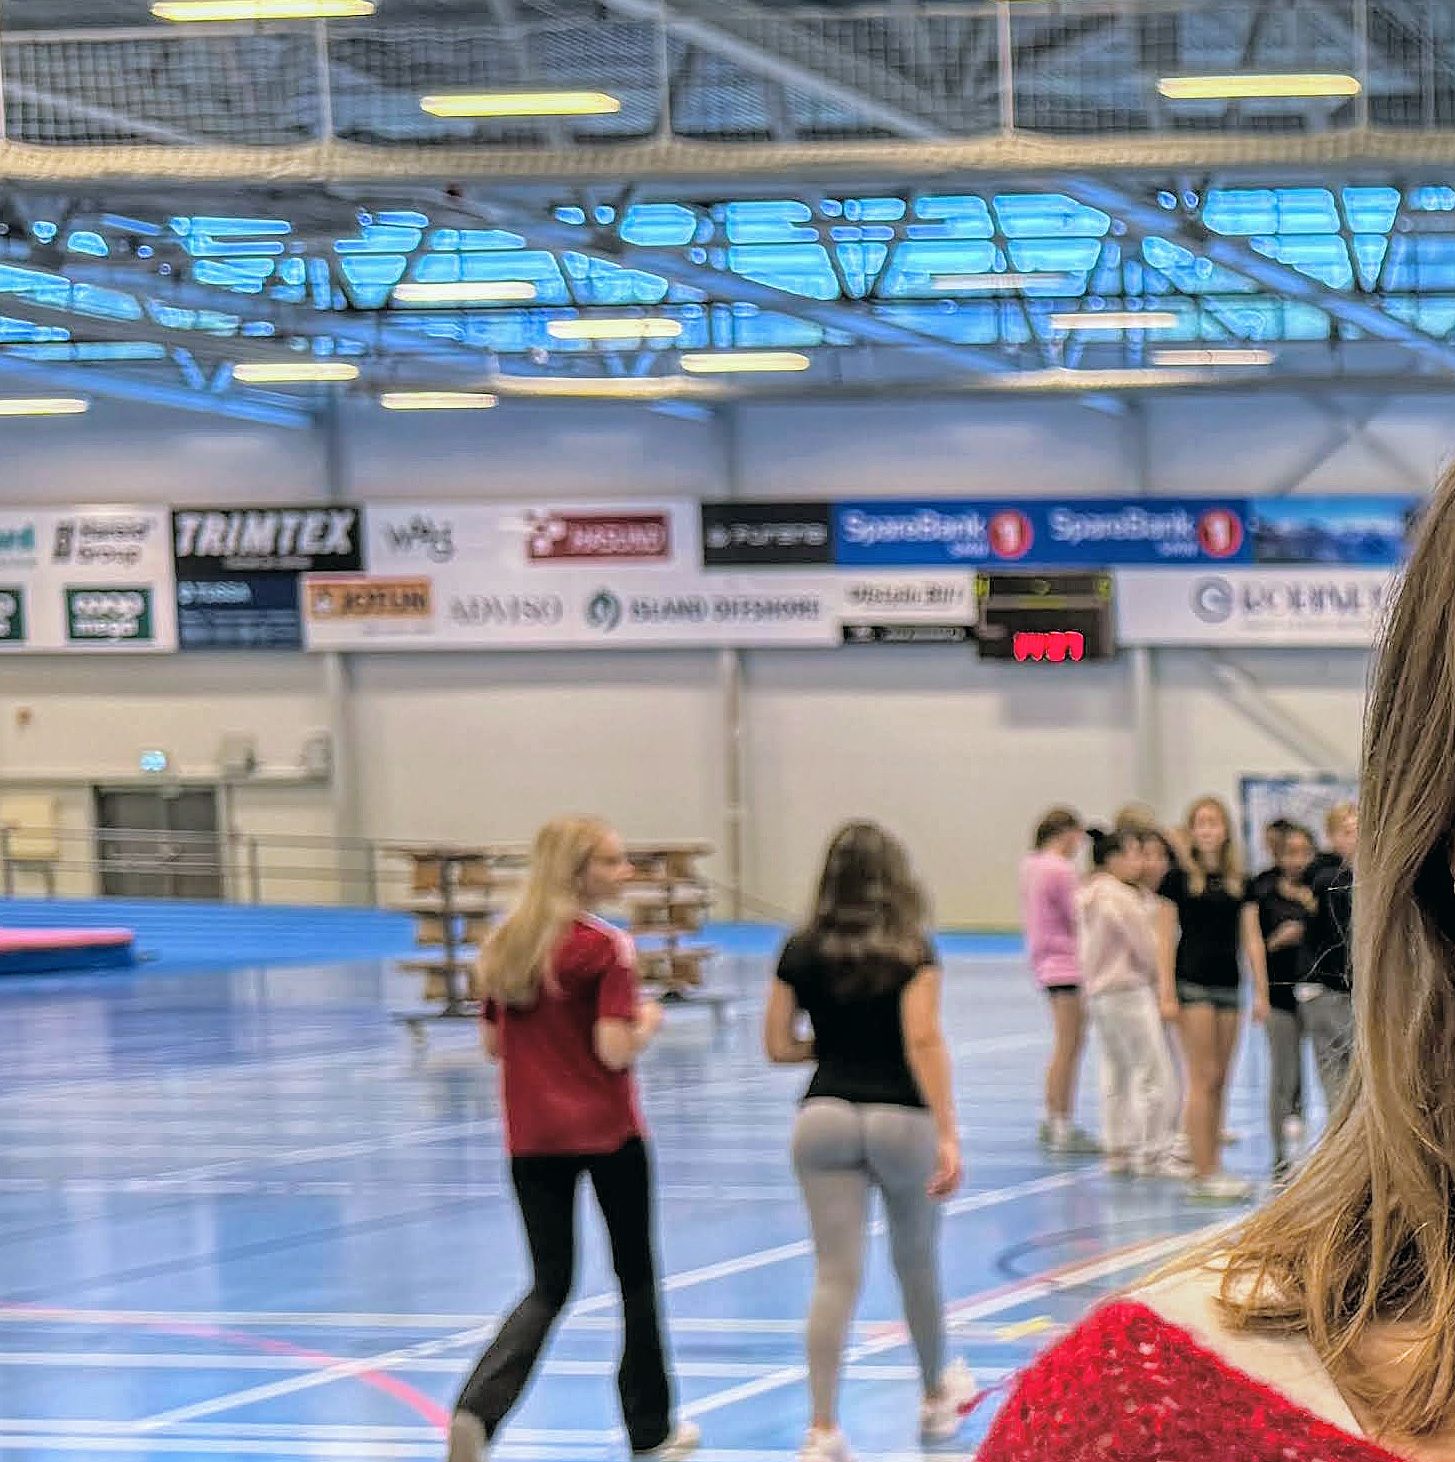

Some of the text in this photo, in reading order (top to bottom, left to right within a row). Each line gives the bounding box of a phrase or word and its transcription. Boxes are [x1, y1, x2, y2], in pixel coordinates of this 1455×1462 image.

[175, 509, 357, 557] TRIMTEX
[841, 508, 990, 546] SpareBank
[1050, 506, 1196, 547] SpareBank
